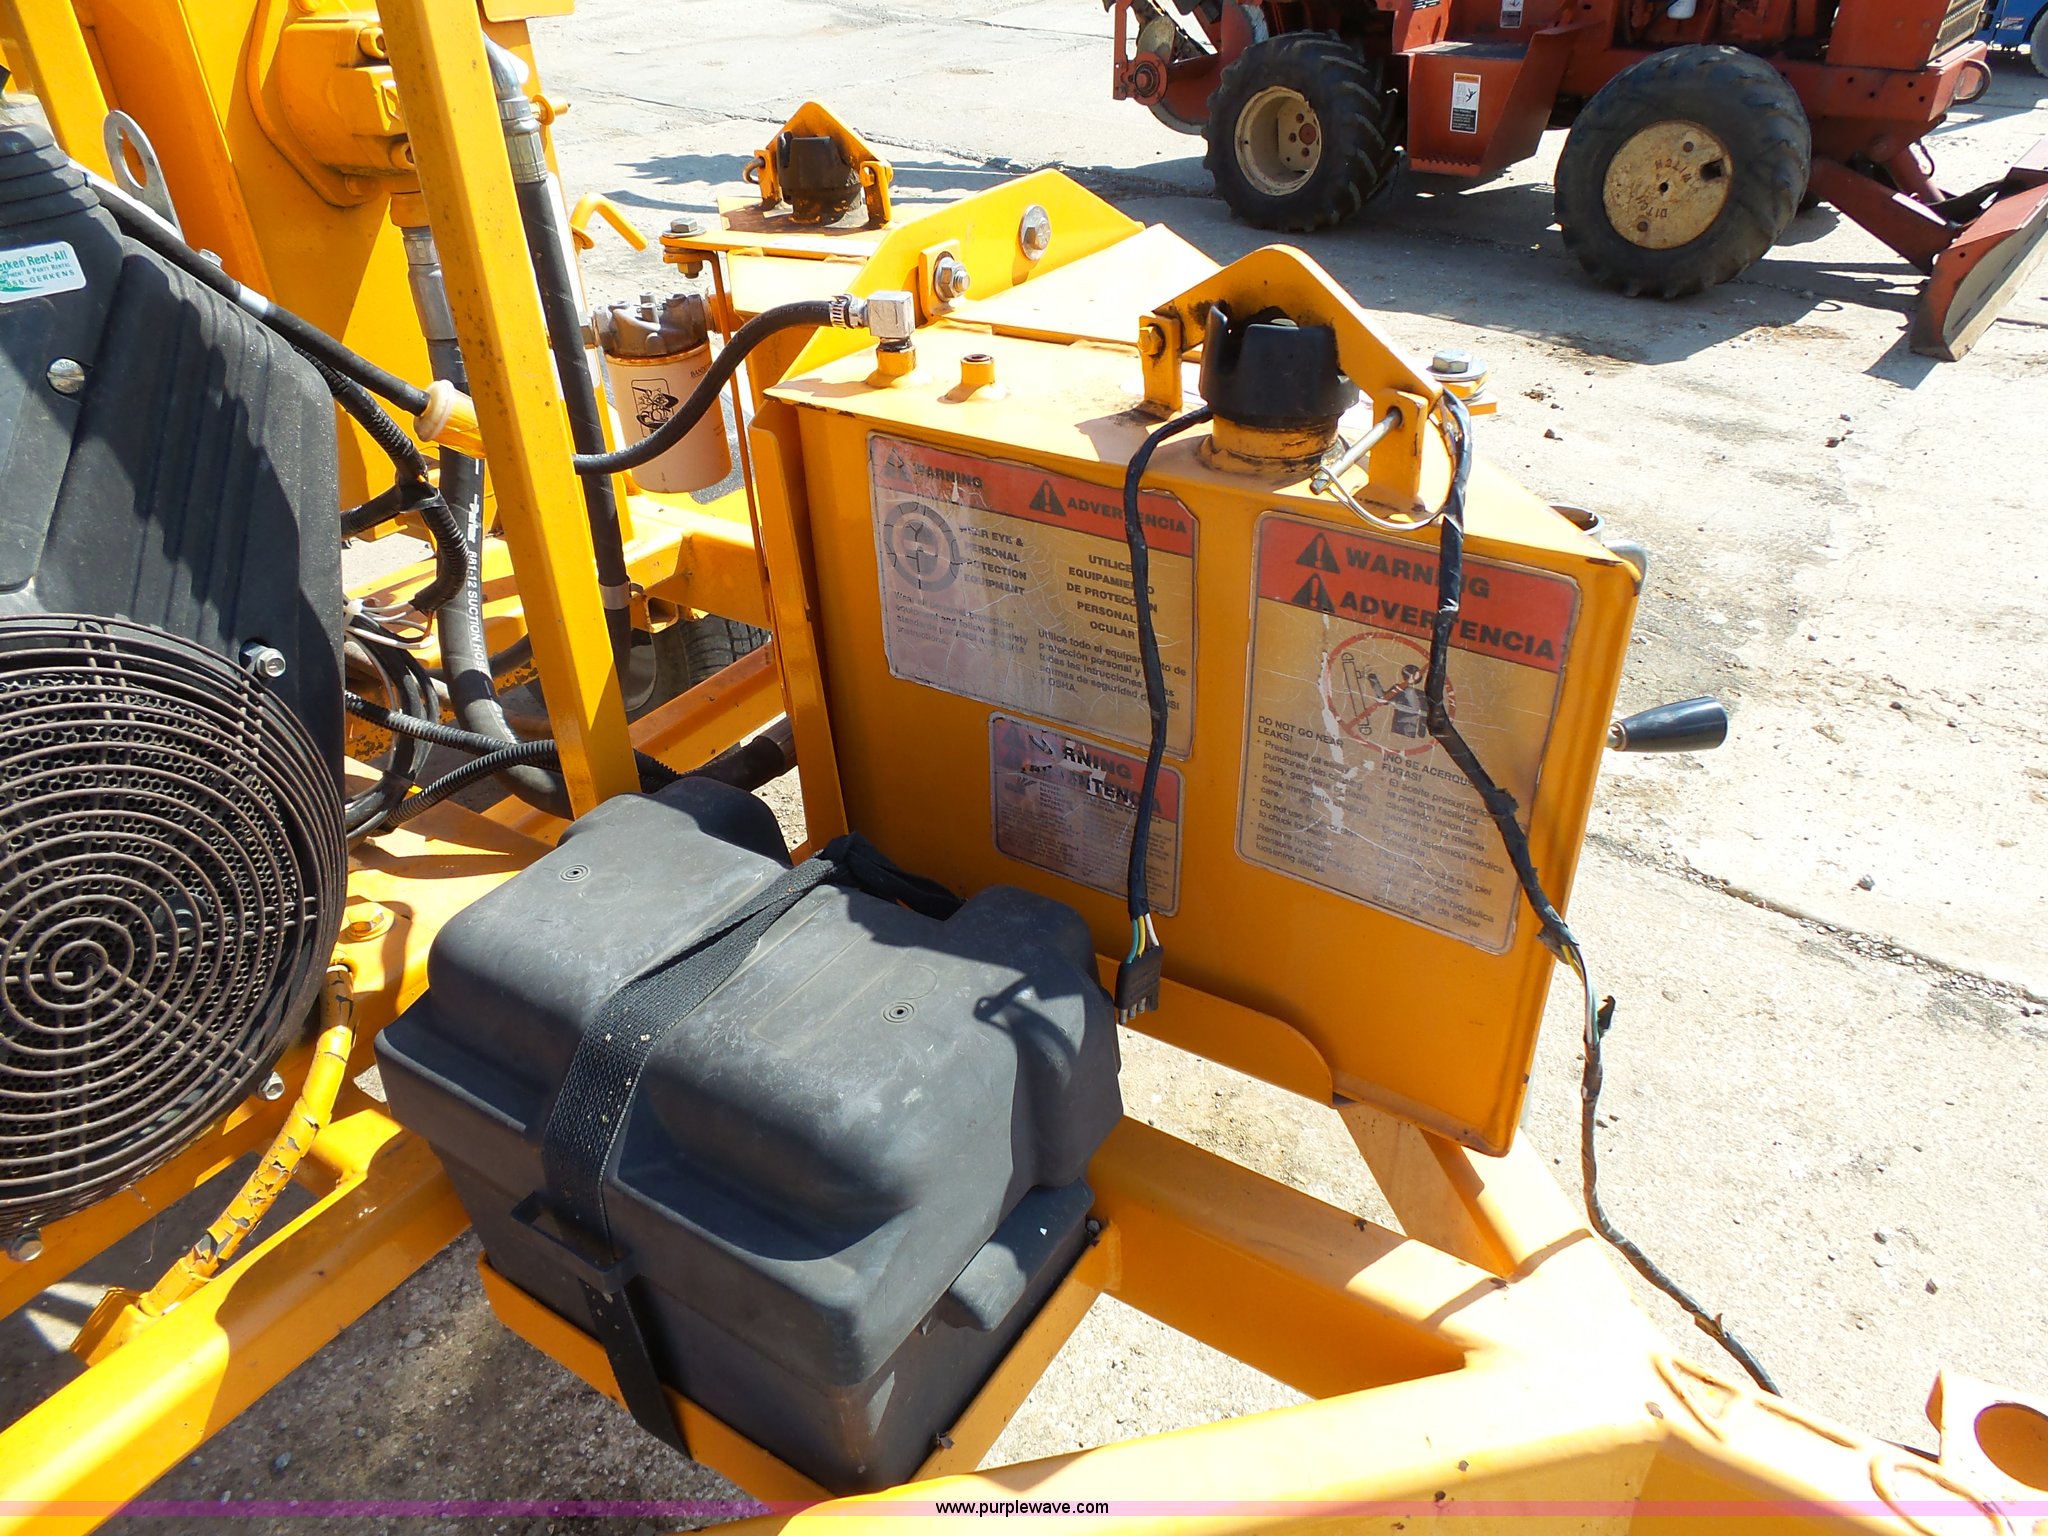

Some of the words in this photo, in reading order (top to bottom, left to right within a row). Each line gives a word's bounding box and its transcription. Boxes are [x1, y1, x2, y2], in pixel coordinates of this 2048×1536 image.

[27, 249, 68, 266] Rent-All
[1066, 496, 1188, 534] ADVERENCIA
[991, 531, 1013, 545] EYE
[1016, 537, 1024, 547] &
[1088, 554, 1133, 573] UTILICE
[1345, 546, 1491, 599] WARNG
[1068, 566, 1155, 595] EQUIPAMIEO
[1066, 582, 1082, 594] DE
[1084, 586, 1158, 614] PROTECCN
[467, 590, 481, 643] SUCTION
[1077, 600, 1137, 624] PERSONAL
[1089, 620, 1136, 640] OCULAR
[1339, 590, 1556, 661] ADVERENCIA
[1067, 660, 1081, 671] las
[1069, 637, 1091, 651] todo
[1093, 645, 1103, 653] el
[1105, 648, 1172, 673] equipato
[1174, 664, 1187, 677] de
[1090, 656, 1132, 674] personal
[1076, 673, 1089, 685] de
[1090, 680, 1138, 699] seguridad
[1257, 725, 1293, 743] LEAKS!
[1258, 714, 1273, 726] DO
[1275, 720, 1296, 733] NOT
[1298, 727, 1314, 739] GO
[1316, 732, 1345, 748] NEAR
[1264, 740, 1309, 760] Pressured
[1263, 752, 1306, 771] punctures
[1405, 760, 1420, 771] SE
[1261, 774, 1284, 790] Seek
[1381, 762, 1422, 784] FUGAS!
[1259, 809, 1268, 819] to
[1260, 798, 1272, 810] Do
